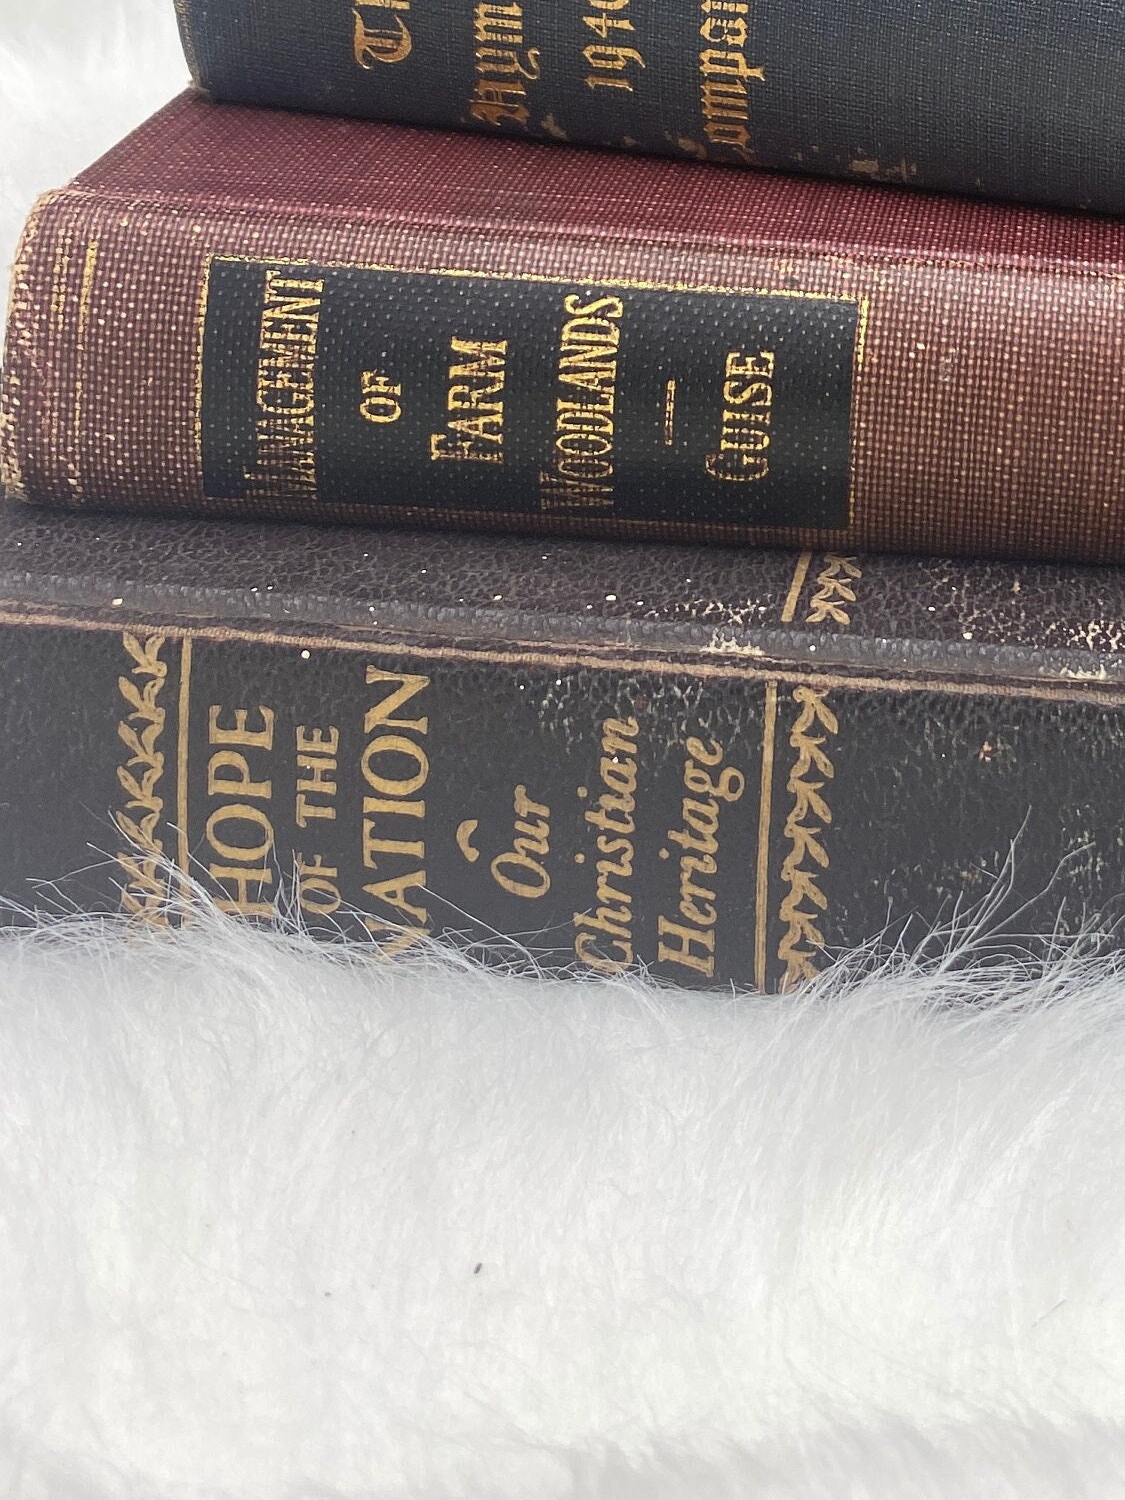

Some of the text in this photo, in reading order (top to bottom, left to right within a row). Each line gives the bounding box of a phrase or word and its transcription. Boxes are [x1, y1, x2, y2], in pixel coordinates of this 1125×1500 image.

[359, 368, 403, 423] OF
[430, 336, 508, 464] FARM
[540, 294, 624, 510] WOODLANDS
[706, 350, 776, 482] GUISE
[206, 705, 274, 919] HOPE
[296, 725, 341, 915] OF THE
[490, 784, 551, 898] Our
[574, 716, 640, 974] Christian
[658, 736, 745, 978] Heritage
